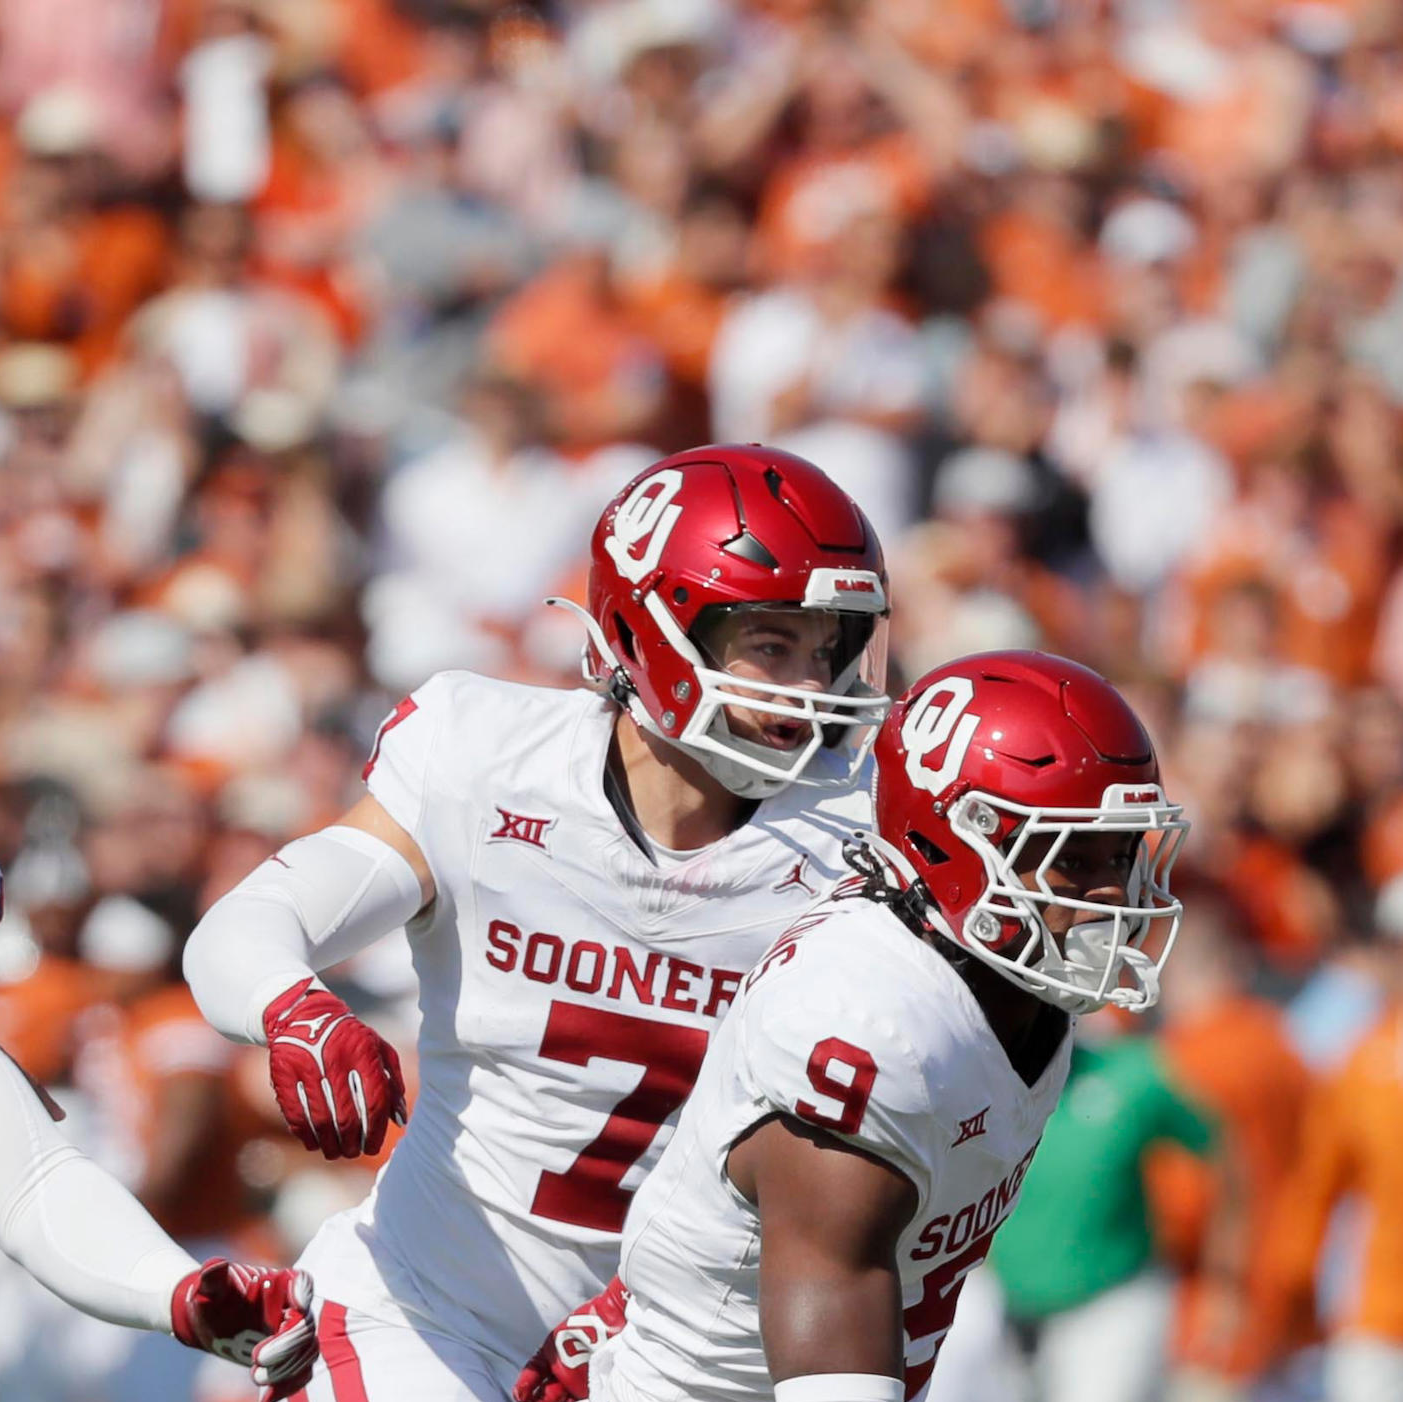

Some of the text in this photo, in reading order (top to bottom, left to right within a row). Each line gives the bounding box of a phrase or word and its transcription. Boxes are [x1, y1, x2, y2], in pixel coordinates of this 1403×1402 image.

[604, 470, 684, 585] OU
[902, 677, 980, 796] OU
[485, 919, 745, 1018] SOONER
[530, 1002, 710, 1233] 7
[795, 1037, 878, 1136] 9
